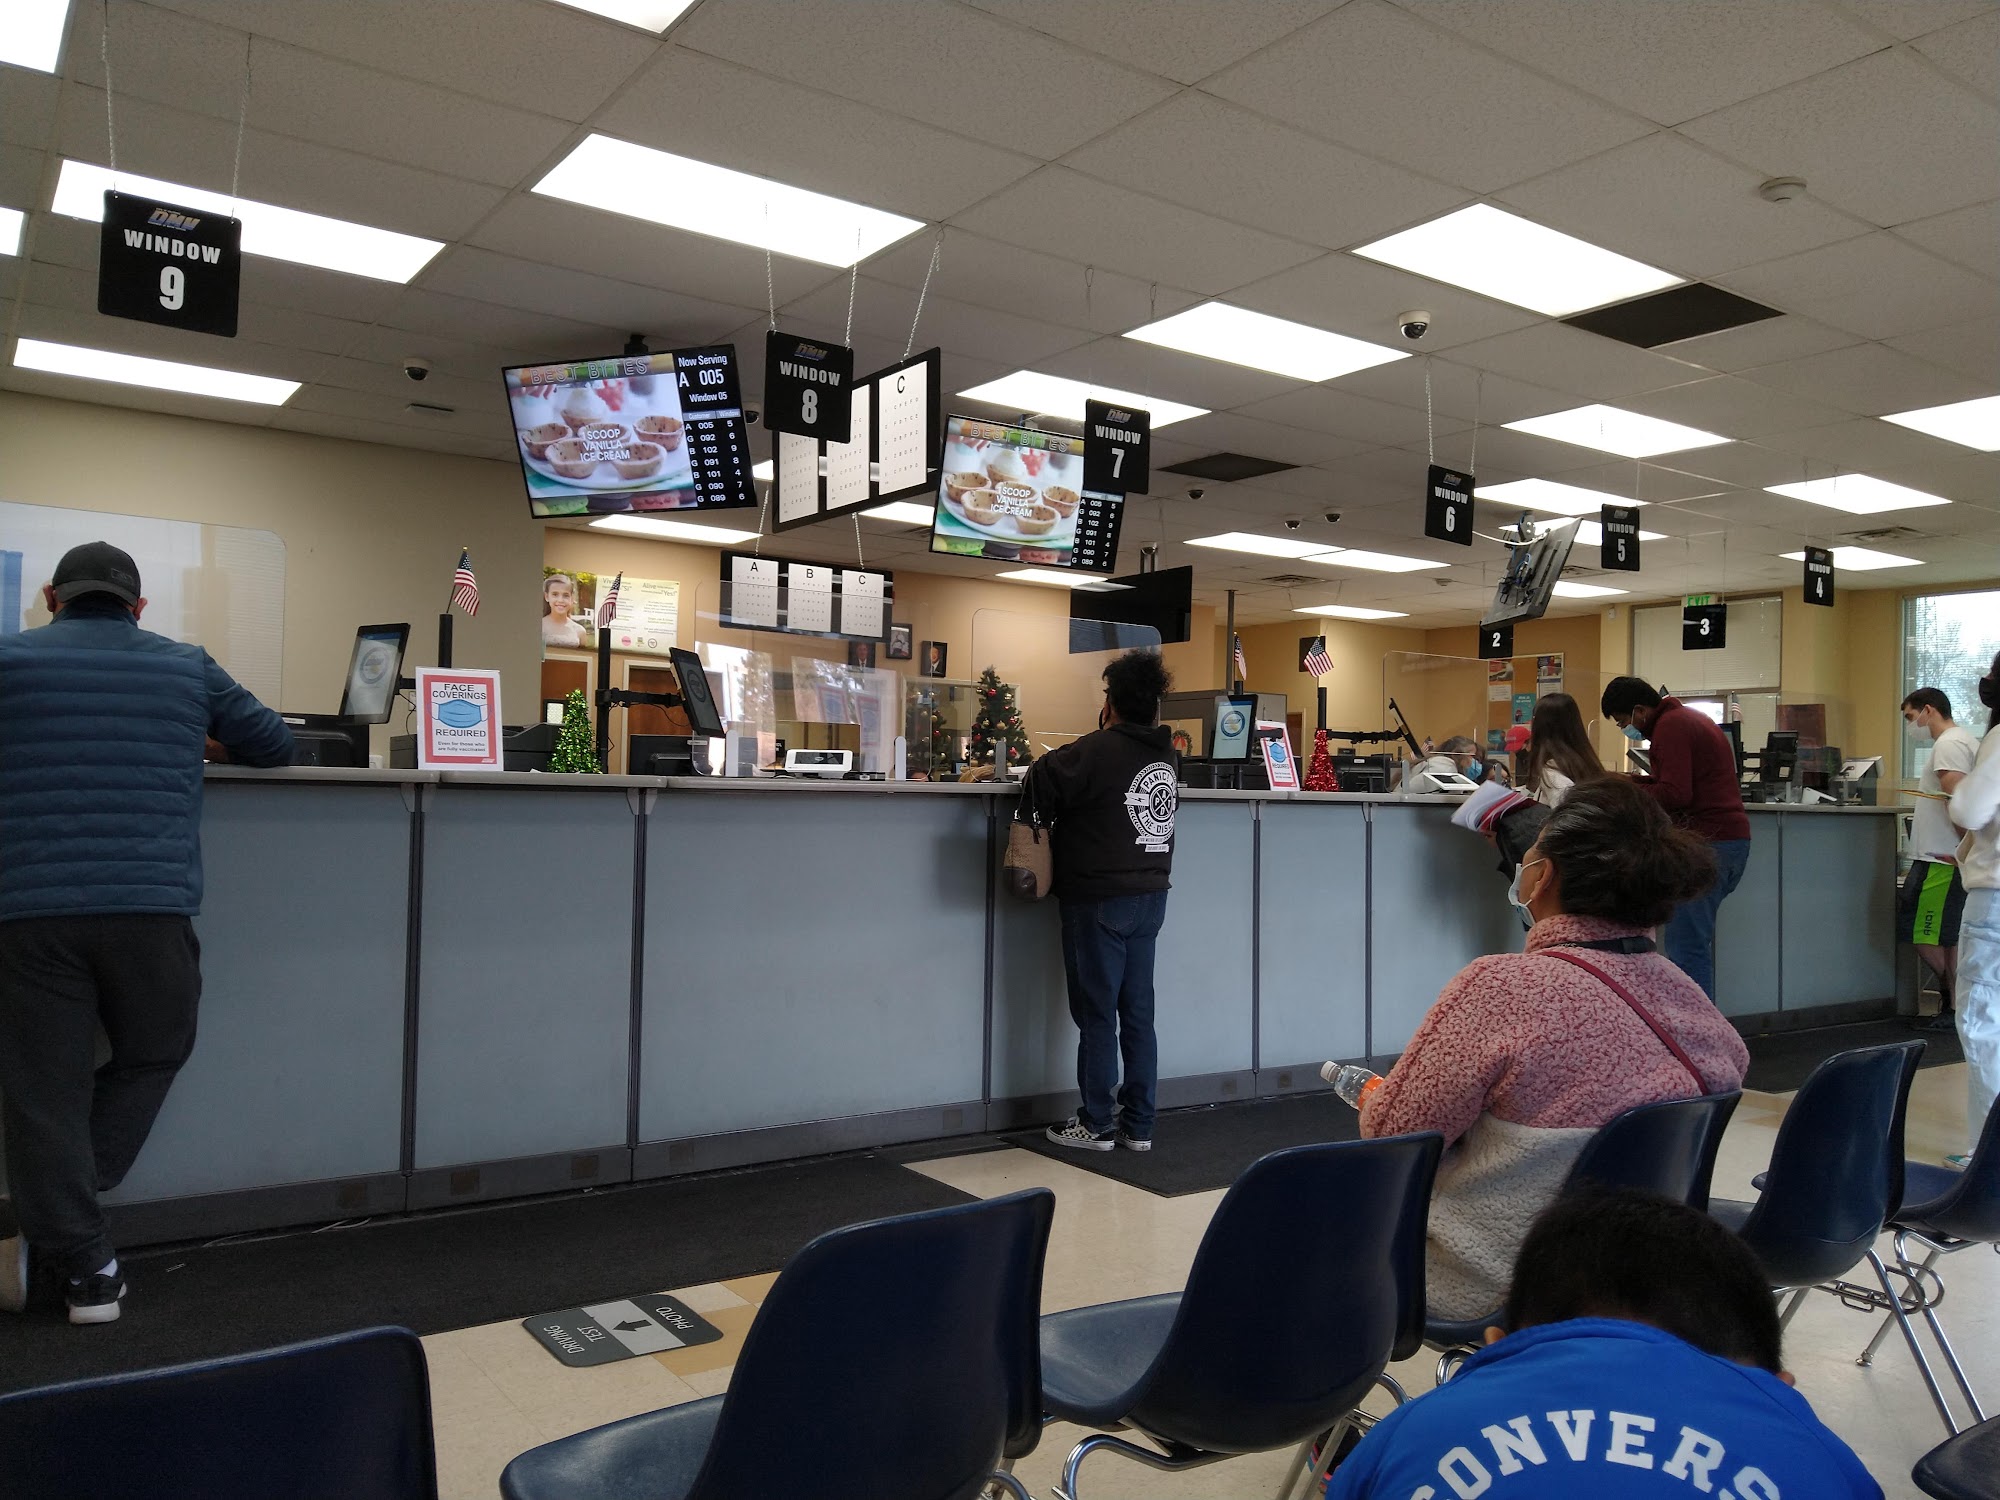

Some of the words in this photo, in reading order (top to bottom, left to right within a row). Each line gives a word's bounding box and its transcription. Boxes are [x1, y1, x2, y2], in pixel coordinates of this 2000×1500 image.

[147, 209, 200, 230] DMV
[124, 229, 221, 264] WINDOW
[159, 266, 185, 310] 9
[678, 357, 697, 367] Now
[697, 354, 728, 365] Serving
[530, 365, 579, 384] BEST
[587, 358, 648, 379] BITES
[679, 372, 690, 388] A
[699, 369, 724, 386] 005
[780, 361, 840, 386] WINDOW
[897, 375, 905, 394] C
[689, 393, 717, 402] Window
[718, 392, 728, 400] 05
[801, 389, 818, 424] 8
[698, 421, 714, 429] 005
[587, 429, 620, 440] SCOOP
[971, 423, 1012, 442] BEST
[1020, 433, 1068, 452] BITES
[1095, 424, 1141, 445] WINDOW
[583, 440, 623, 451] VANILLA
[689, 447, 696, 455] B
[580, 453, 596, 462] ICE
[596, 450, 630, 461] CREAM
[691, 459, 698, 467] G
[704, 458, 719, 466] 091
[1111, 447, 1125, 478] 7
[996, 495, 1028, 507] VANILLA
[1002, 487, 1031, 498] SCOOP
[1434, 486, 1468, 504] WINDOW
[990, 504, 1004, 512] ICE
[1004, 507, 1032, 517] CREAM
[1445, 506, 1456, 532] 6
[1607, 522, 1635, 534] WINDOW
[1617, 538, 1625, 562] 5
[750, 562, 759, 572] A
[806, 569, 814, 579] B
[858, 575, 866, 585] C
[1816, 577, 1823, 598] 4
[1687, 594, 1711, 607] EXIT
[1699, 617, 1710, 636] 3
[1492, 632, 1501, 647] 2
[432, 690, 487, 700] COVERINGS
[444, 684, 474, 692] FACE
[435, 728, 486, 738] REQUIRED
[1143, 771, 1170, 790] PANIC!
[1141, 812, 1154, 830] THE
[655, 1306, 695, 1331] PHOTO
[543, 1324, 585, 1354] DRIVING
[576, 1325, 606, 1343] TEST
[1410, 1409, 1781, 1500] ONVERS
